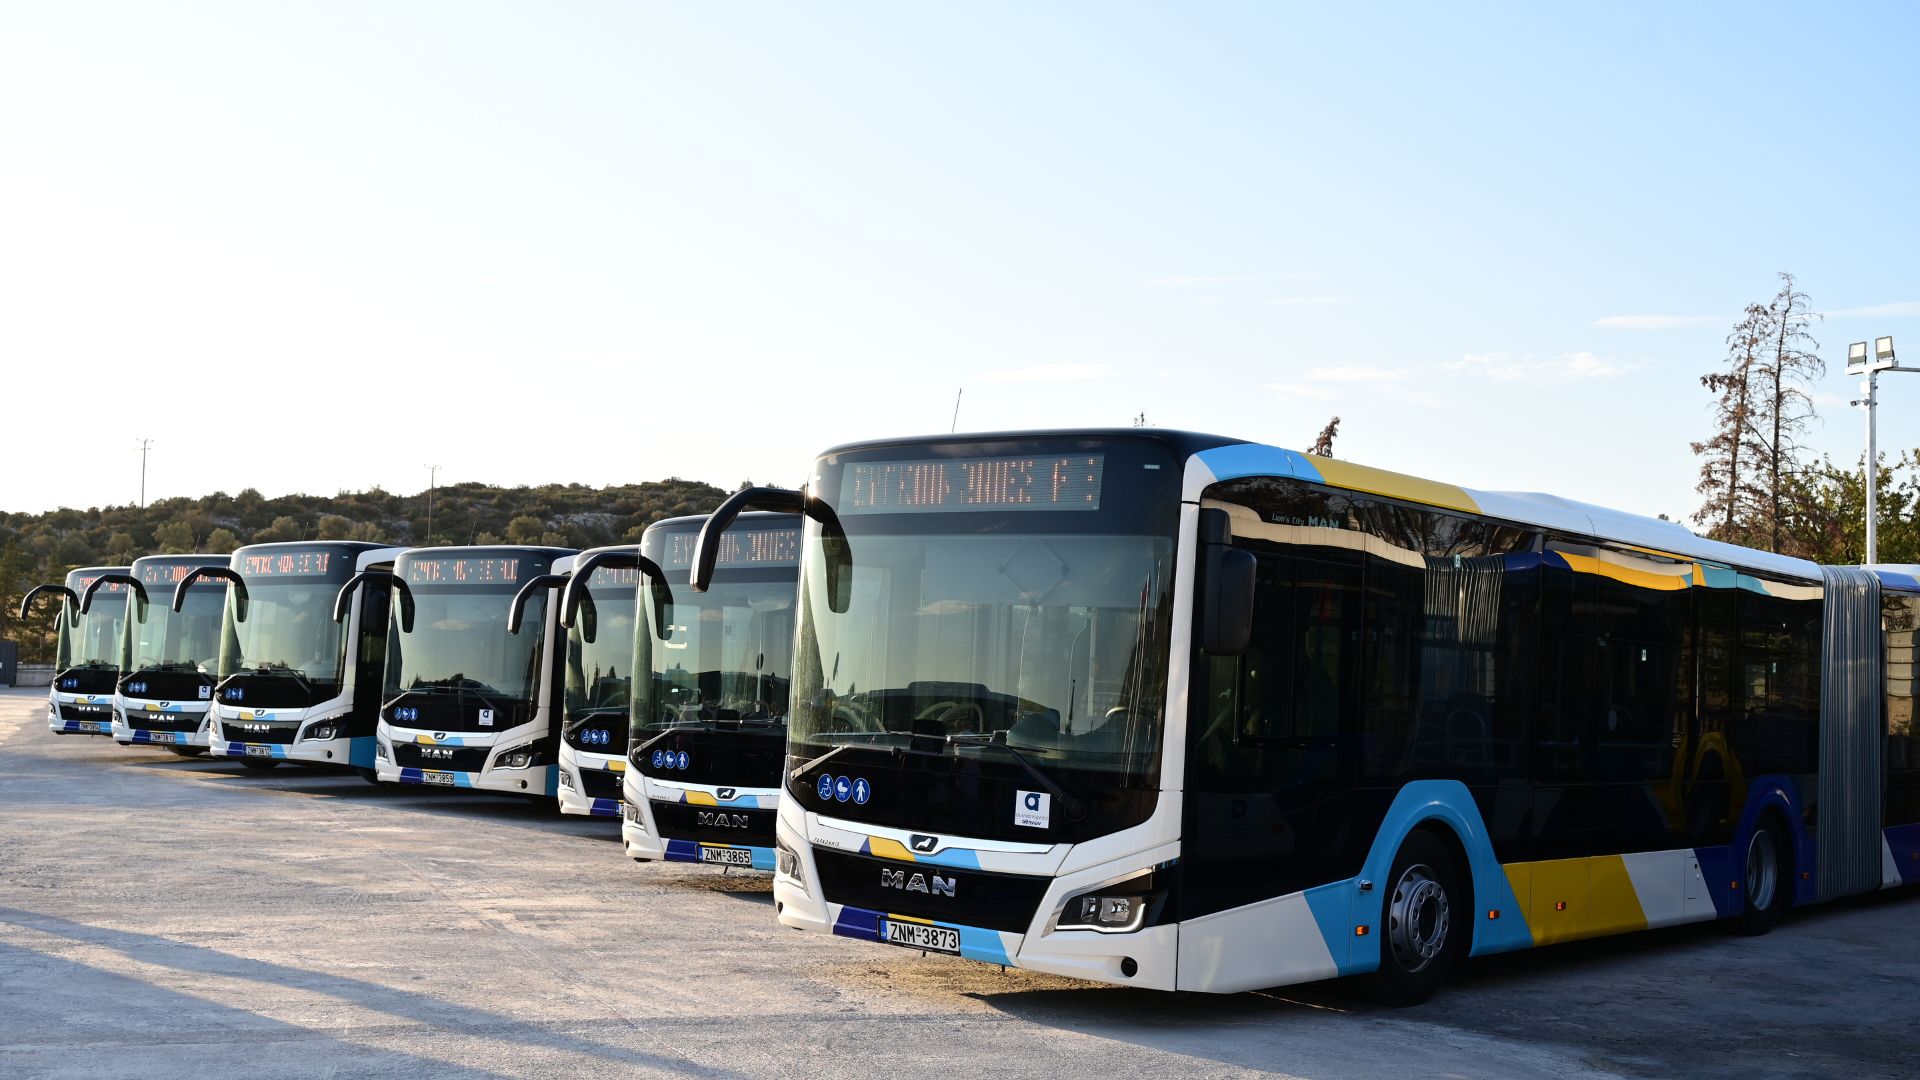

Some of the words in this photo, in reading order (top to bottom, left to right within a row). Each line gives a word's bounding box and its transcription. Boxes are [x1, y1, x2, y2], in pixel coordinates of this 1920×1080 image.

[1308, 515, 1339, 528] MAN
[149, 714, 175, 722] MAN
[244, 723, 270, 733] MAN
[421, 748, 453, 759] MAN
[698, 811, 748, 829] MAN
[704, 848, 750, 863] ZNM-3865
[881, 868, 956, 897] MAN
[890, 923, 957, 949] ZNM-3873
